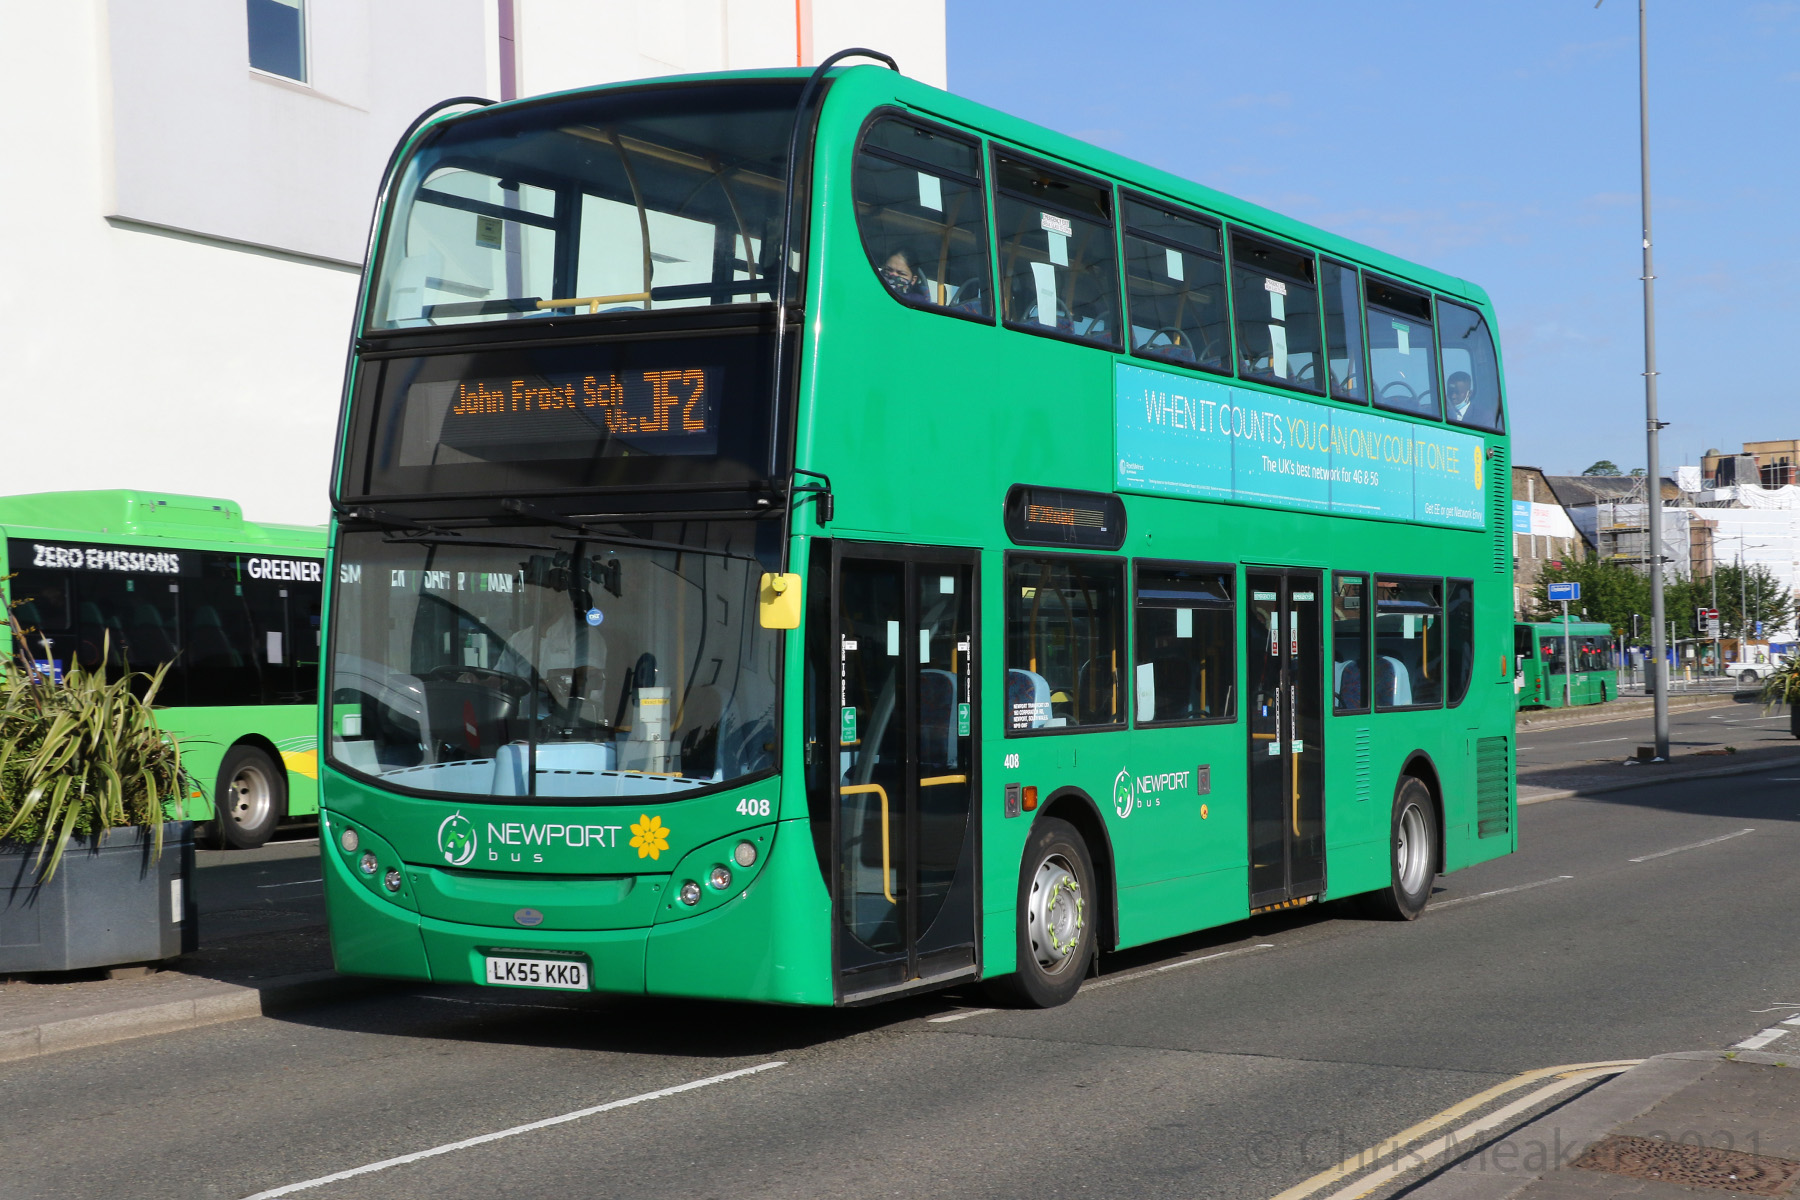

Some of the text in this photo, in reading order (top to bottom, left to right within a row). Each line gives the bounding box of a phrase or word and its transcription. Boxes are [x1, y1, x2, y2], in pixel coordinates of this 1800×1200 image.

[453, 368, 705, 432] John Frost Sch JF2
[1144, 388, 1460, 474] WHEN IT COUNTS, YOU CAN ONLY COUNT ON EE
[1261, 455, 1379, 486] The UK's best network for 4G & 5G
[1425, 502, 1434, 515] Get
[1446, 506, 1454, 519] get
[1454, 506, 1472, 519] Network
[1472, 508, 1483, 522] Envy
[32, 544, 180, 573] ZERO EMISSIONS
[247, 557, 322, 582] GREENER
[1004, 753, 1020, 769] 408
[1136, 771, 1190, 794] NEWPORT
[736, 797, 771, 816] 408
[1137, 797, 1160, 808] bus
[487, 822, 623, 848] NEWPORT
[488, 848, 543, 863] bus
[494, 961, 540, 982] LK55
